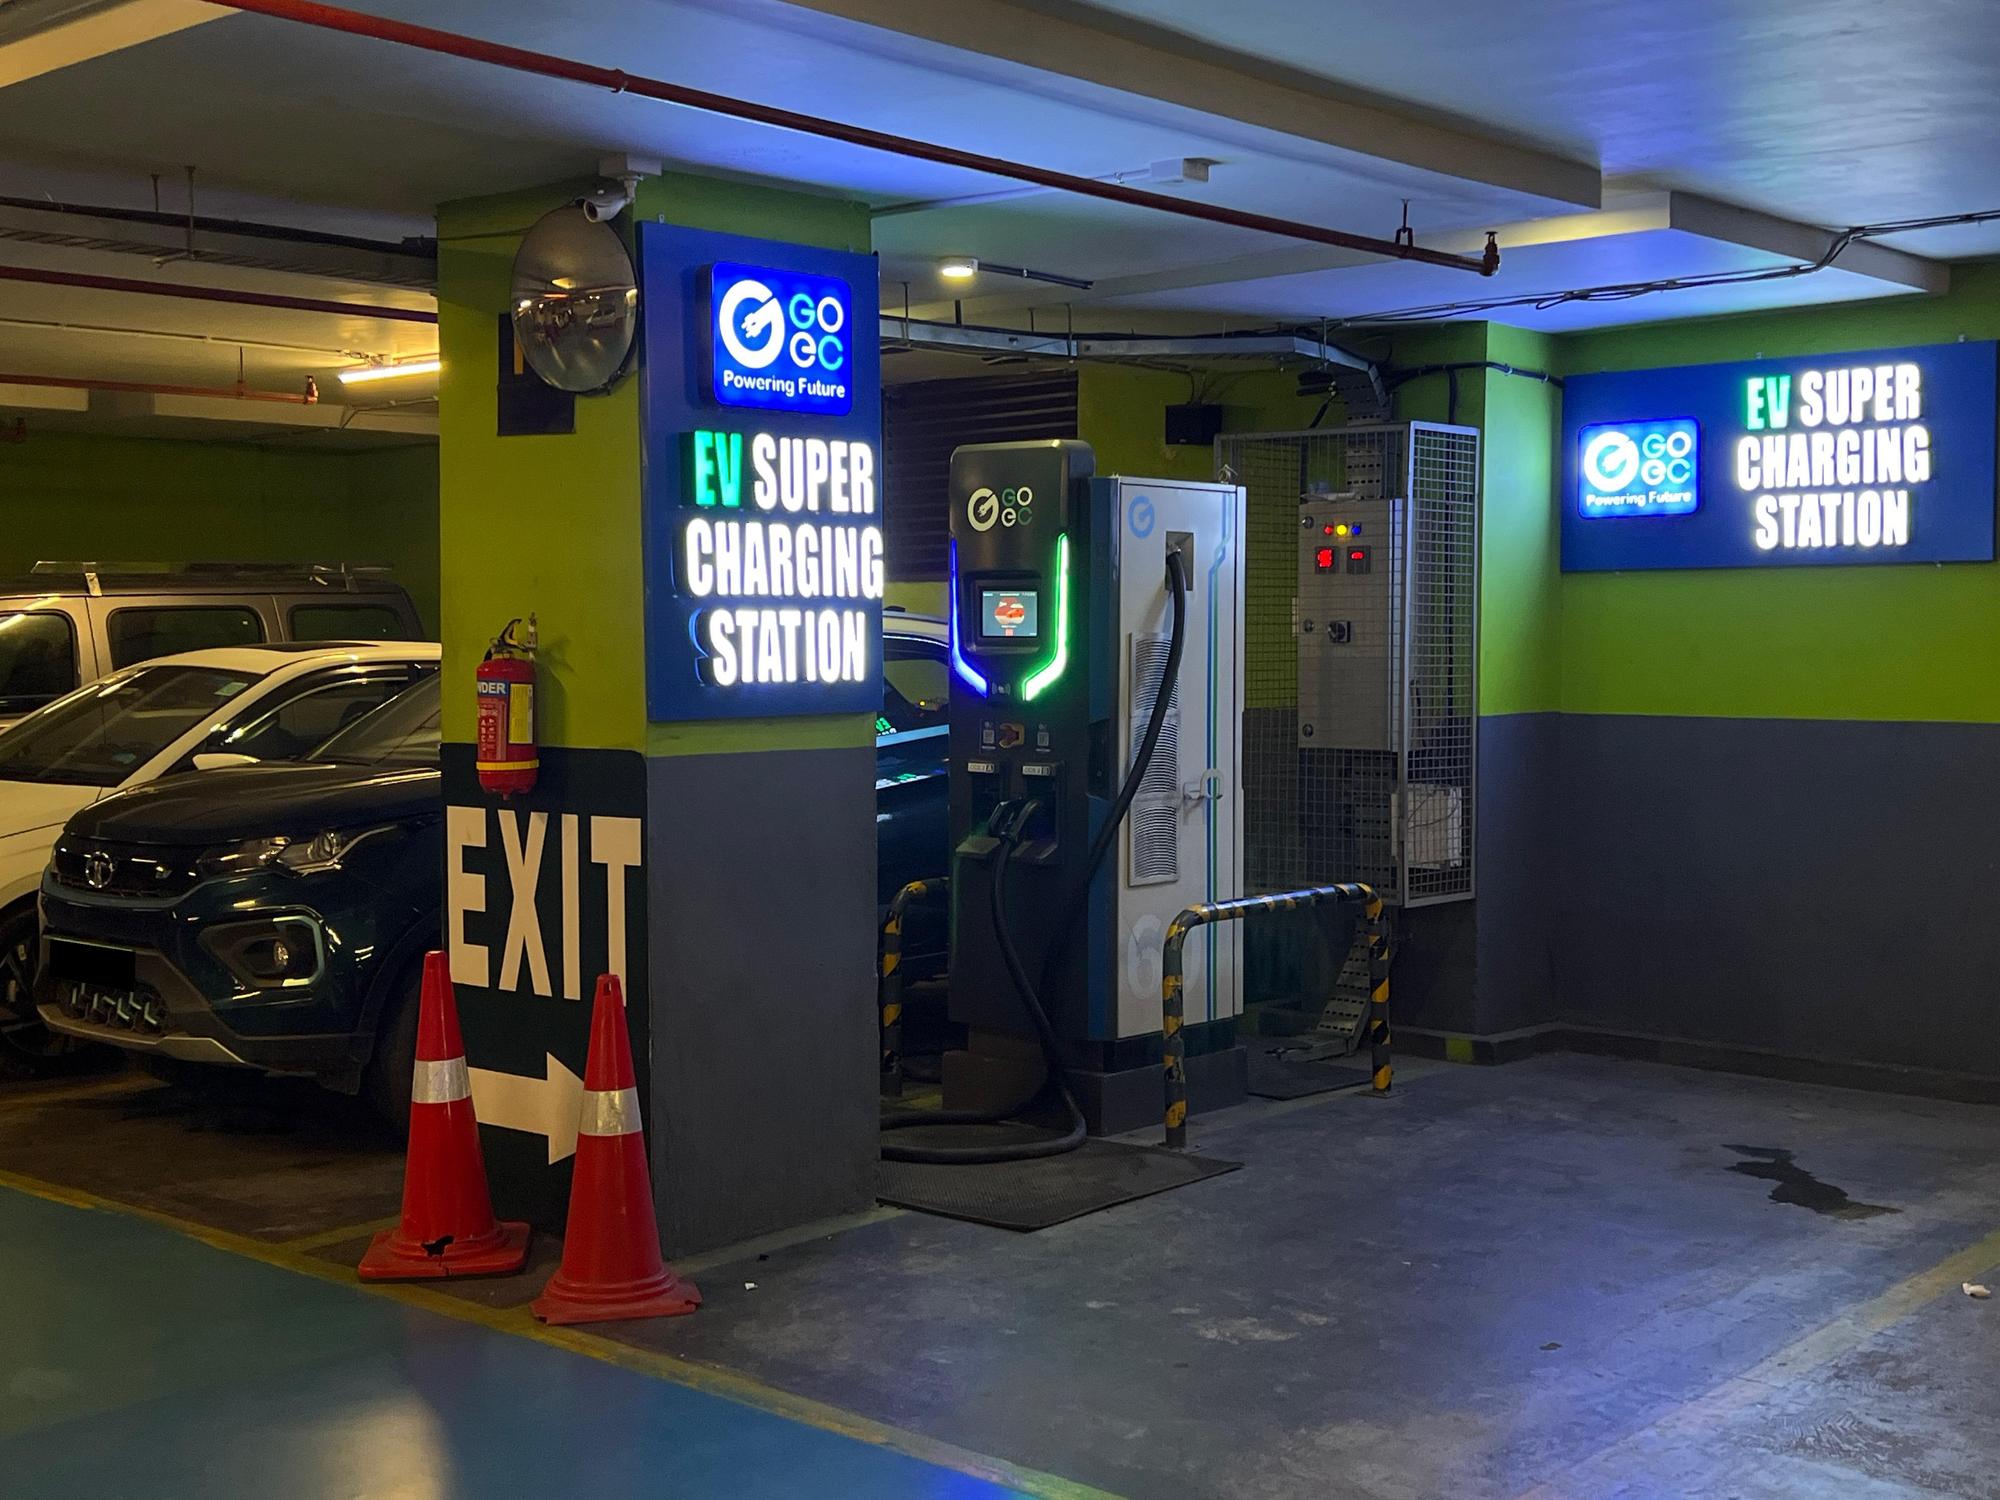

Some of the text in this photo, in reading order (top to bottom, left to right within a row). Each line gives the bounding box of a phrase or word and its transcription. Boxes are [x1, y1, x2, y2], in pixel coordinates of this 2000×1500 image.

[789, 293, 844, 333] GO
[723, 370, 845, 398] Powering Future
[1746, 364, 1921, 430] EV SUPER
[694, 430, 875, 514] EV SUPER
[1642, 431, 1692, 459] GO
[1737, 425, 1931, 491] CHARGING
[1002, 486, 1033, 506] GO
[1586, 491, 1692, 507] Powering Future
[1755, 490, 1909, 550] STATION
[686, 518, 883, 599] CHARGING
[709, 608, 866, 686] STATION
[478, 682, 506, 694] DER
[446, 805, 641, 1008] EXIT
